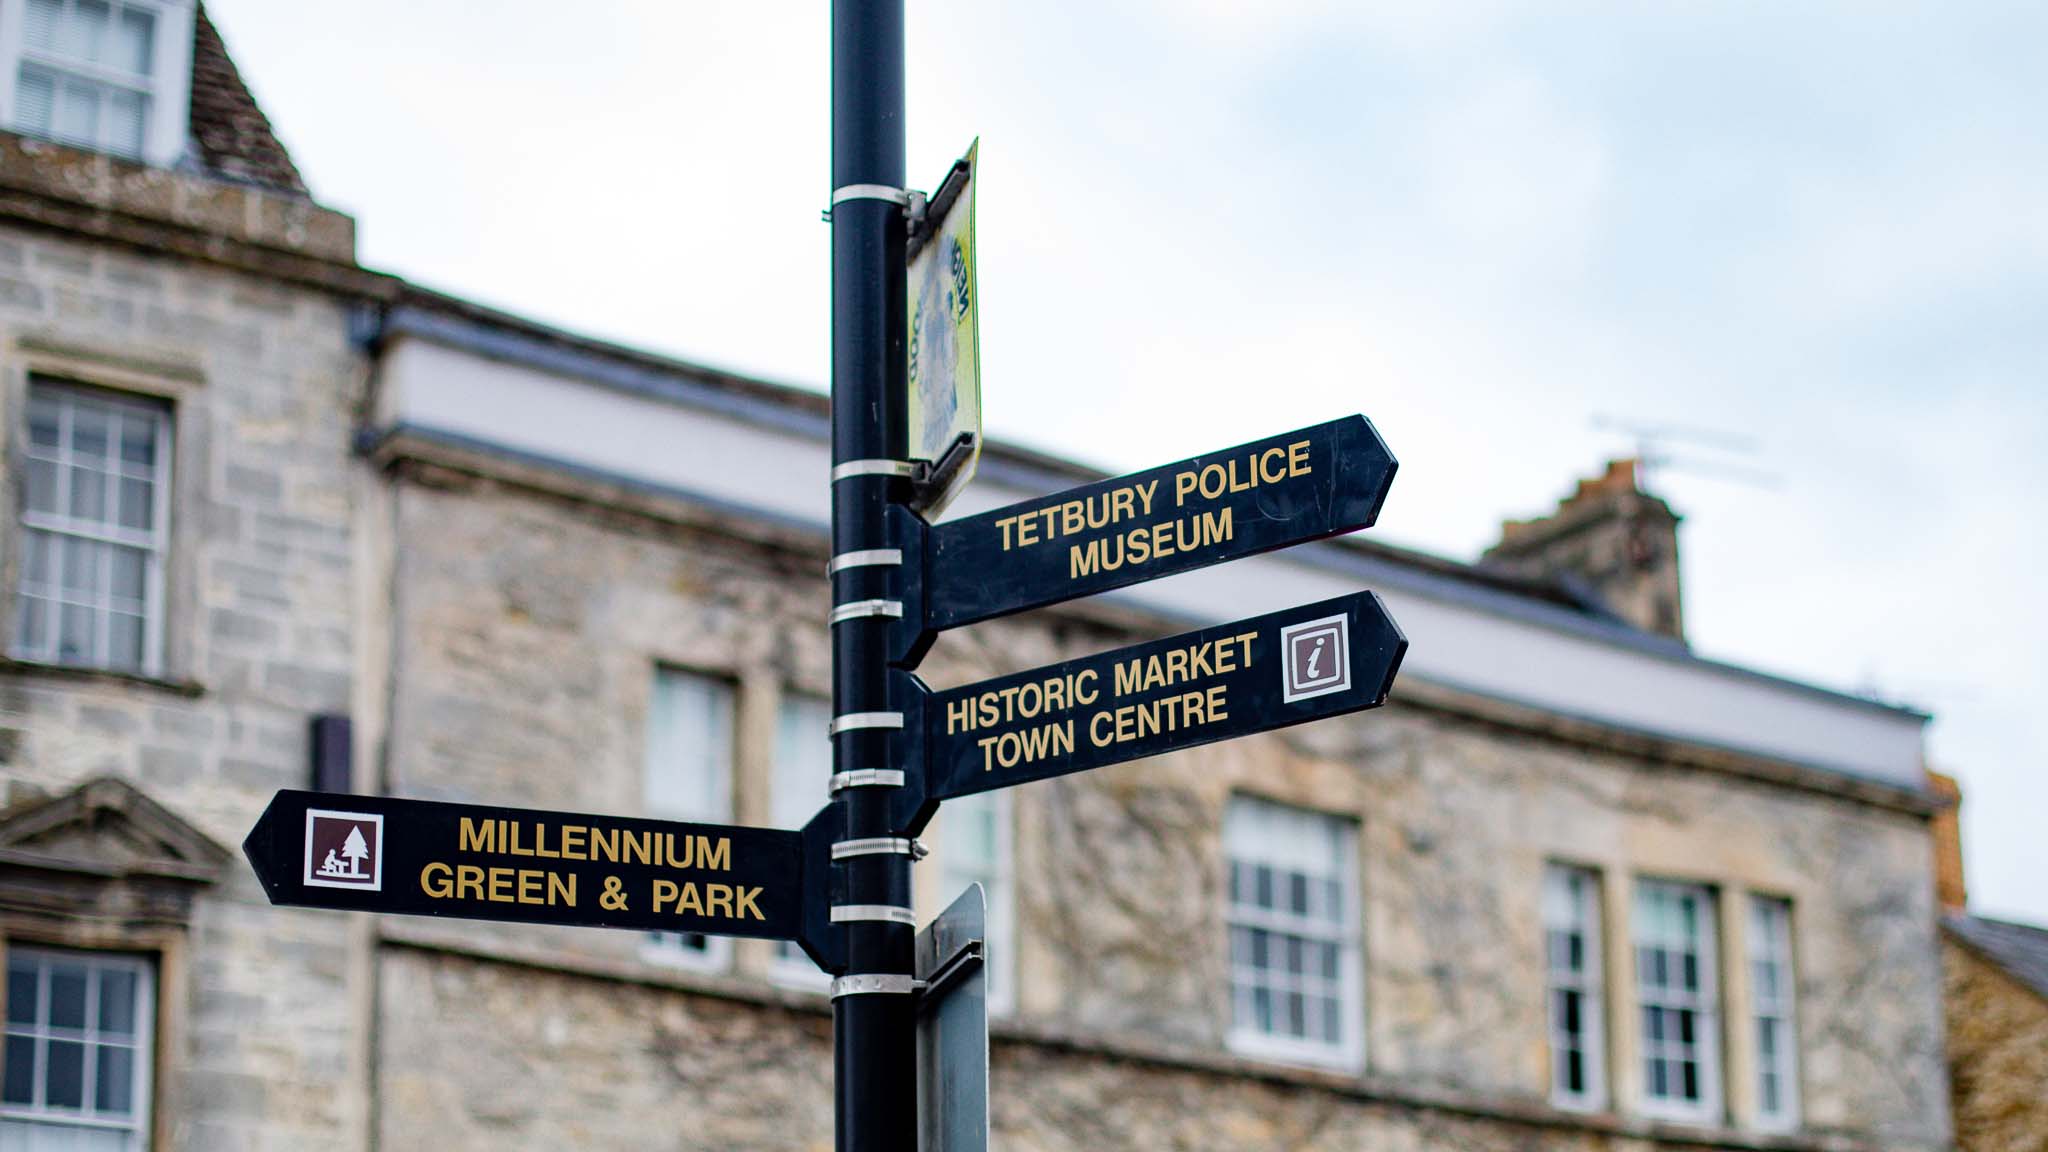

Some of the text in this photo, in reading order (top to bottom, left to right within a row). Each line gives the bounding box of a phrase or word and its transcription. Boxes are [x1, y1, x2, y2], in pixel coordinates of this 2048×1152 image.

[995, 439, 1313, 551] TETBURY POLICE
[1069, 507, 1234, 580] MUSEUM
[946, 631, 1259, 736] HISTORIC MARKET
[977, 684, 1229, 772] TOWN CENTRE
[458, 816, 732, 872] MILLENNIUM
[419, 861, 766, 922] GREEN & PARK
